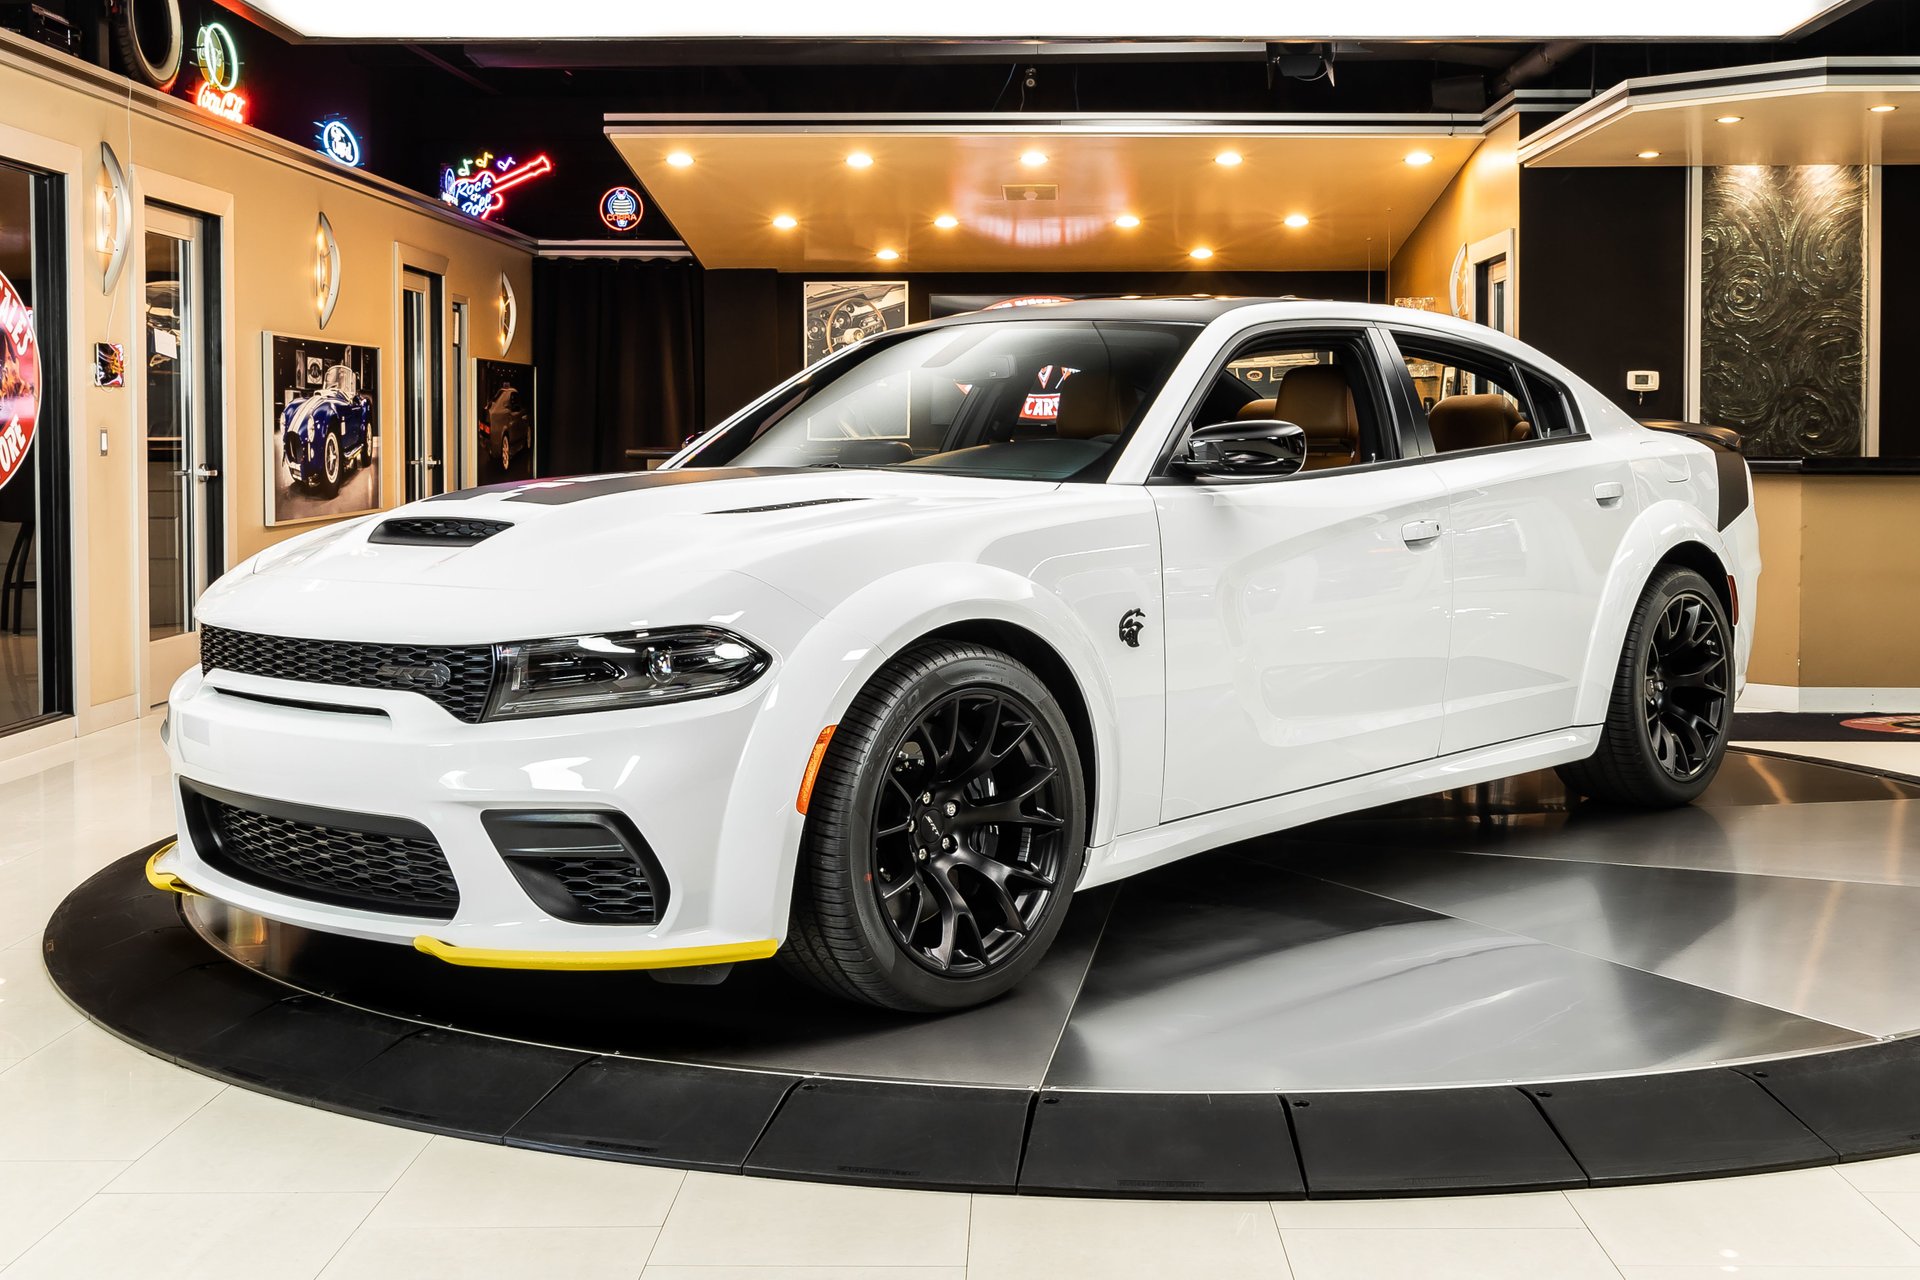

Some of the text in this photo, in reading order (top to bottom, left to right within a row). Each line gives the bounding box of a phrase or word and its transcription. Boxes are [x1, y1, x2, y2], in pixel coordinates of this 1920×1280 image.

[456, 173, 491, 199] Rock
[606, 213, 637, 221] COBRA
[375, 664, 435, 681] SRT
